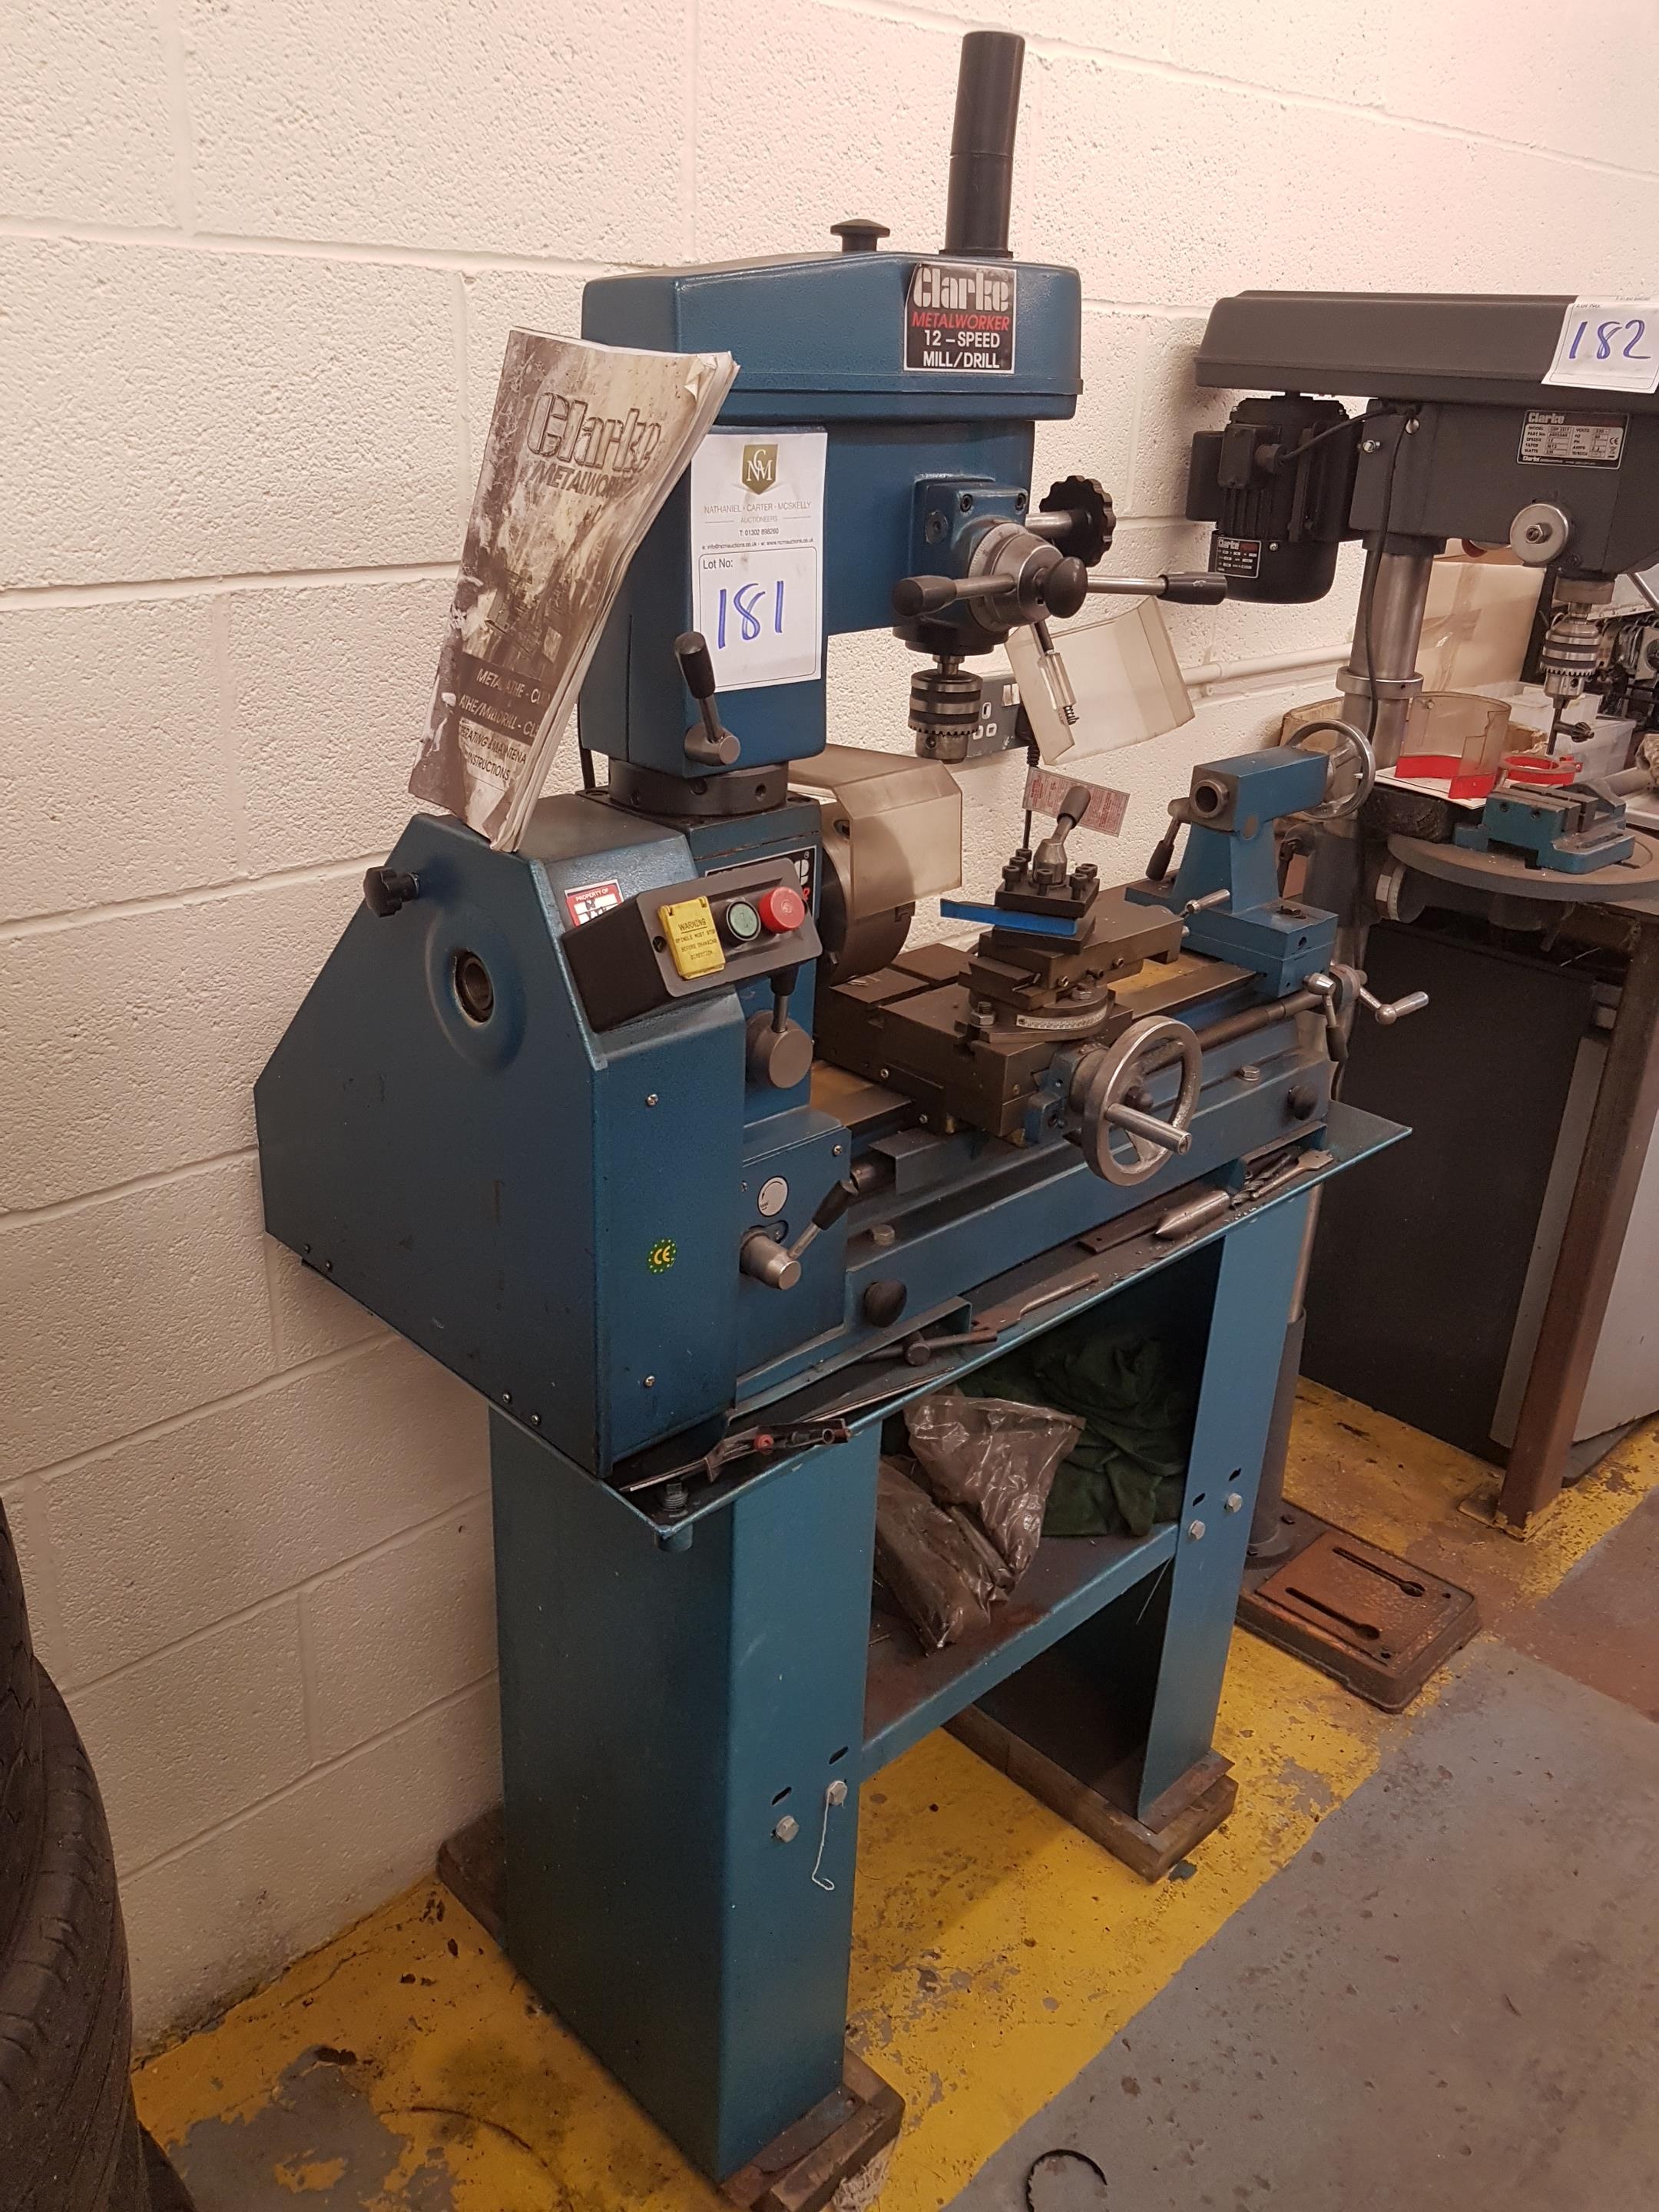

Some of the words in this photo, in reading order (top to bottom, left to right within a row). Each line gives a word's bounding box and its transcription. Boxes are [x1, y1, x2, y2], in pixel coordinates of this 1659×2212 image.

[913, 267, 1008, 312] Clarke
[912, 312, 1010, 331] METALWORKER
[924, 329, 942, 346] 12
[1569, 320, 1651, 359] 182
[923, 350, 1000, 369] MILL/DRILL
[1528, 412, 1565, 424] Clarke
[528, 392, 661, 473] Clarke
[530, 461, 634, 498] METALWOR
[704, 505, 741, 514] NATHANIEL
[746, 503, 773, 512] CARTER
[740, 515, 778, 524] AUCTIONEERS
[703, 559, 717, 570] Lot
[719, 558, 733, 569] No:
[718, 581, 783, 649] 181
[575, 890, 601, 902] PROPERTY
[678, 918, 707, 931] WARNING
